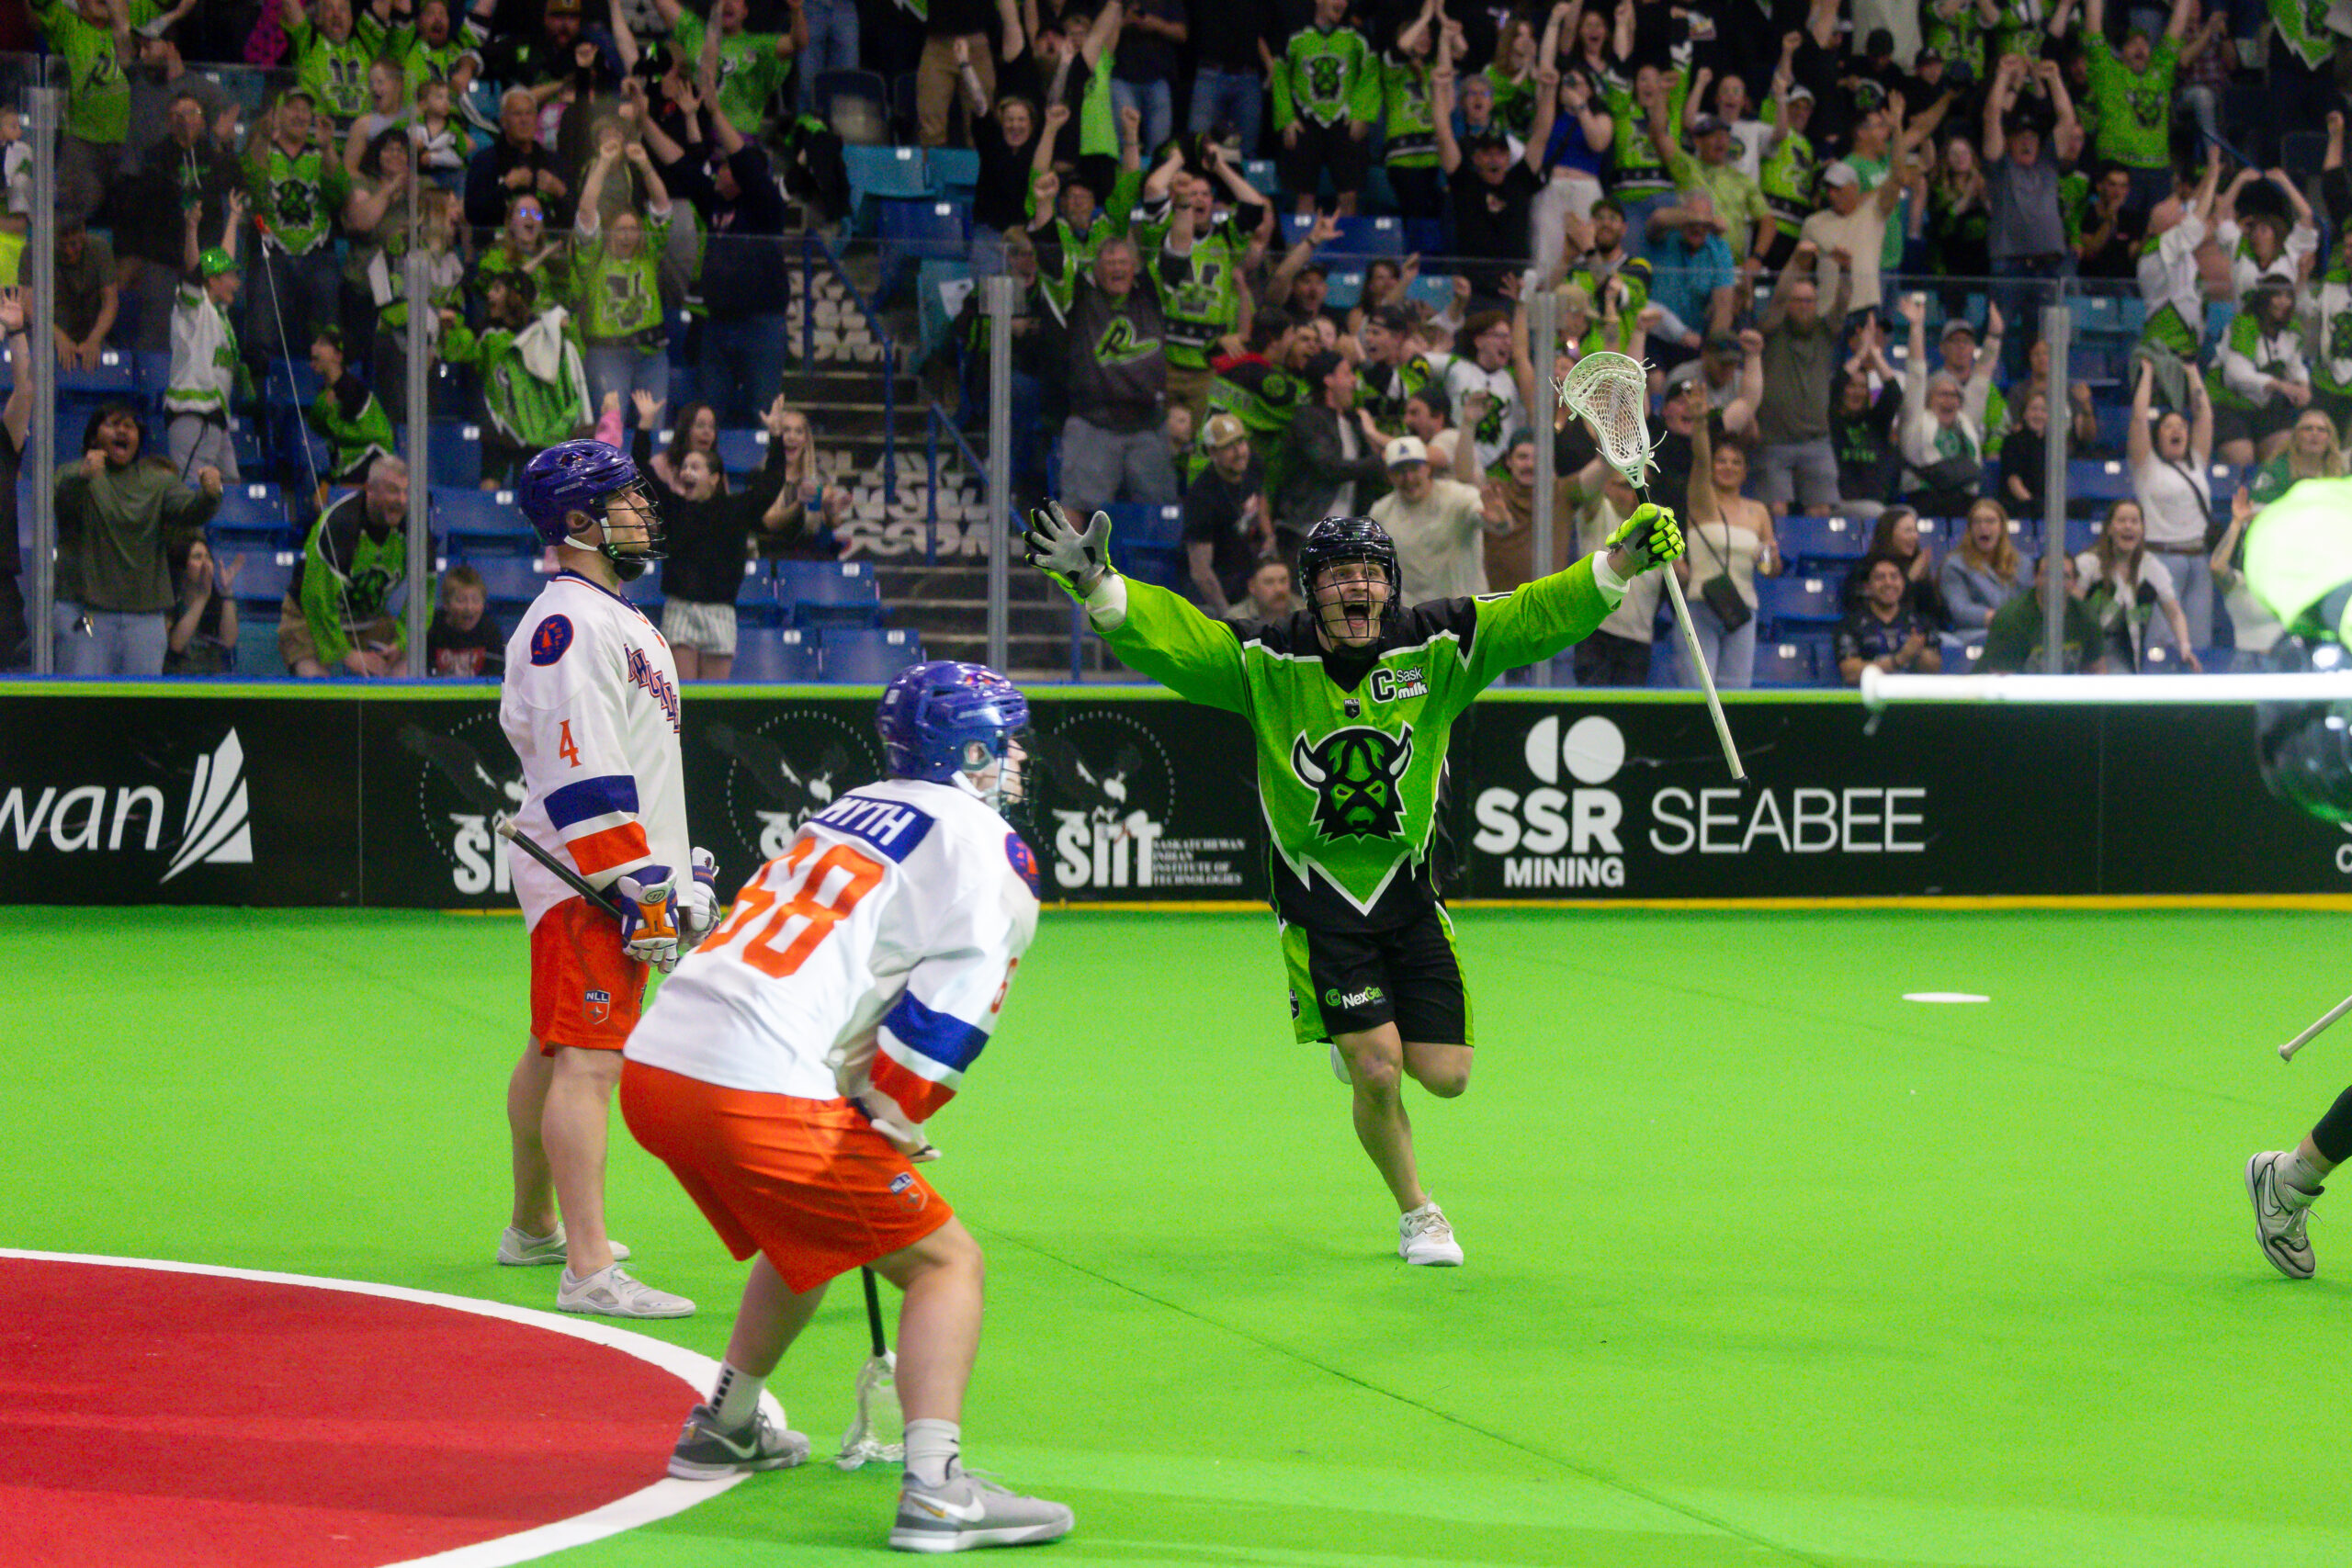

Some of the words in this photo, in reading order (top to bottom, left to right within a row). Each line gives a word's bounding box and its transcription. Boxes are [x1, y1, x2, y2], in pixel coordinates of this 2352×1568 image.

[1370, 668, 1396, 704] C
[1396, 667, 1423, 682] Sask
[1397, 682, 1429, 699] milk
[560, 719, 582, 768] 4
[1473, 787, 1623, 854] SSR
[1650, 787, 1926, 854] SEABEE
[1504, 857, 1624, 887] MINING
[586, 992, 608, 1001] NLL
